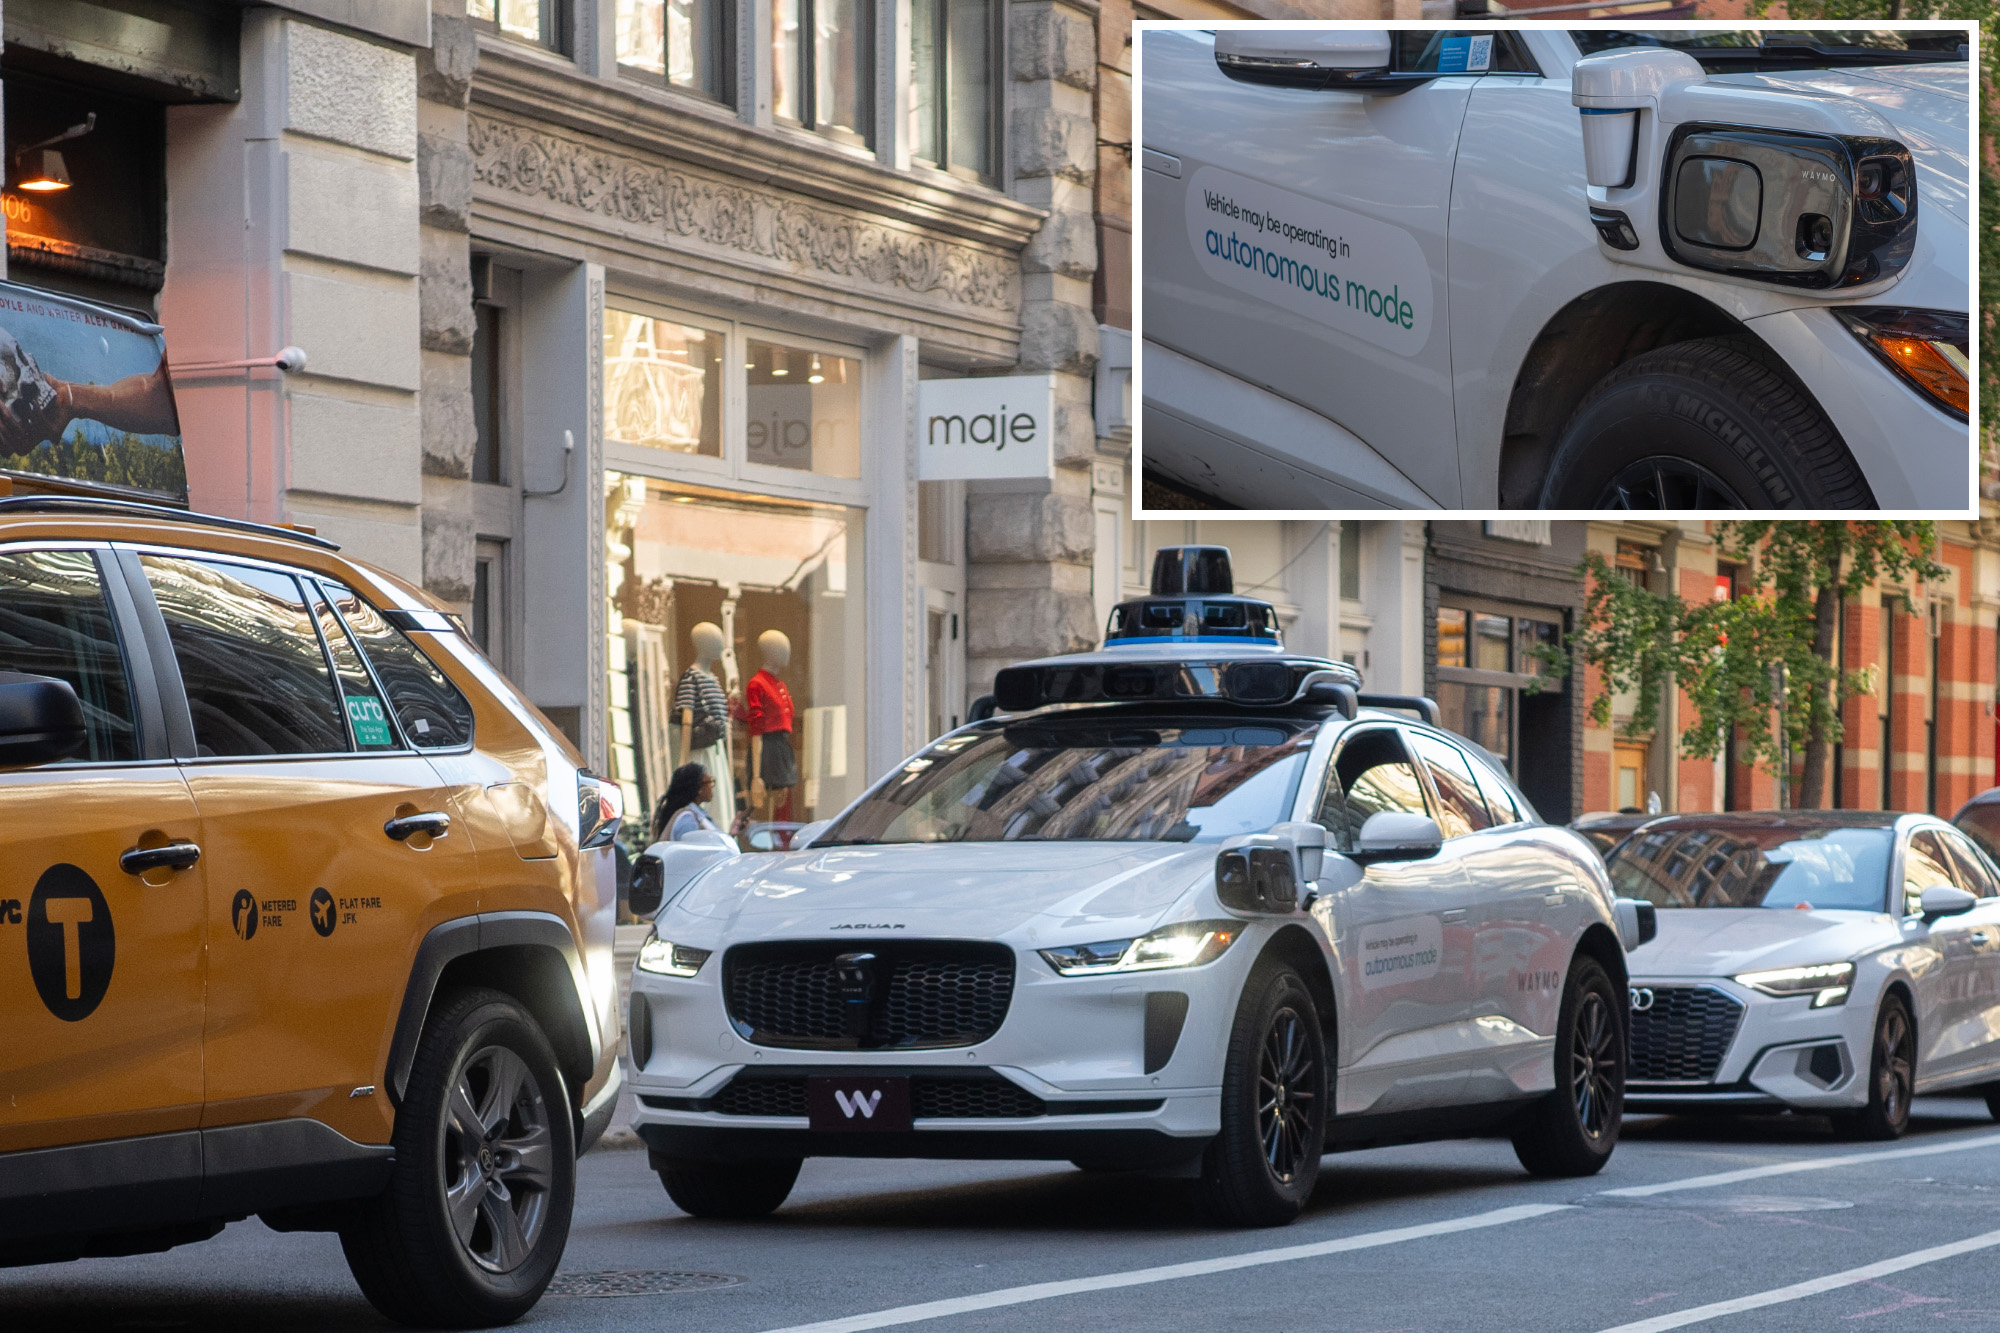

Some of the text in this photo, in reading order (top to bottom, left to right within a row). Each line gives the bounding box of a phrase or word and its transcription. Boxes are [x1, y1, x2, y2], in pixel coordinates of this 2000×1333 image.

[1801, 170, 1836, 182] WAYMO
[1204, 189, 1350, 259] Vehicle may be operating in
[1205, 229, 1414, 330] autonomous mode
[27, 304, 45, 316] AND
[47, 307, 81, 323] WRITER
[85, 314, 108, 328] ALEX
[929, 405, 1036, 451] maje
[1673, 393, 1793, 503] MICHELIN
[348, 698, 384, 721] curb
[261, 900, 297, 912] METERED
[340, 897, 381, 909] FLAT FARE
[263, 916, 282, 927] FARE
[342, 913, 357, 924] JFK
[1365, 944, 1438, 976] autonomous mode
[1518, 970, 1560, 992] WAYMO
